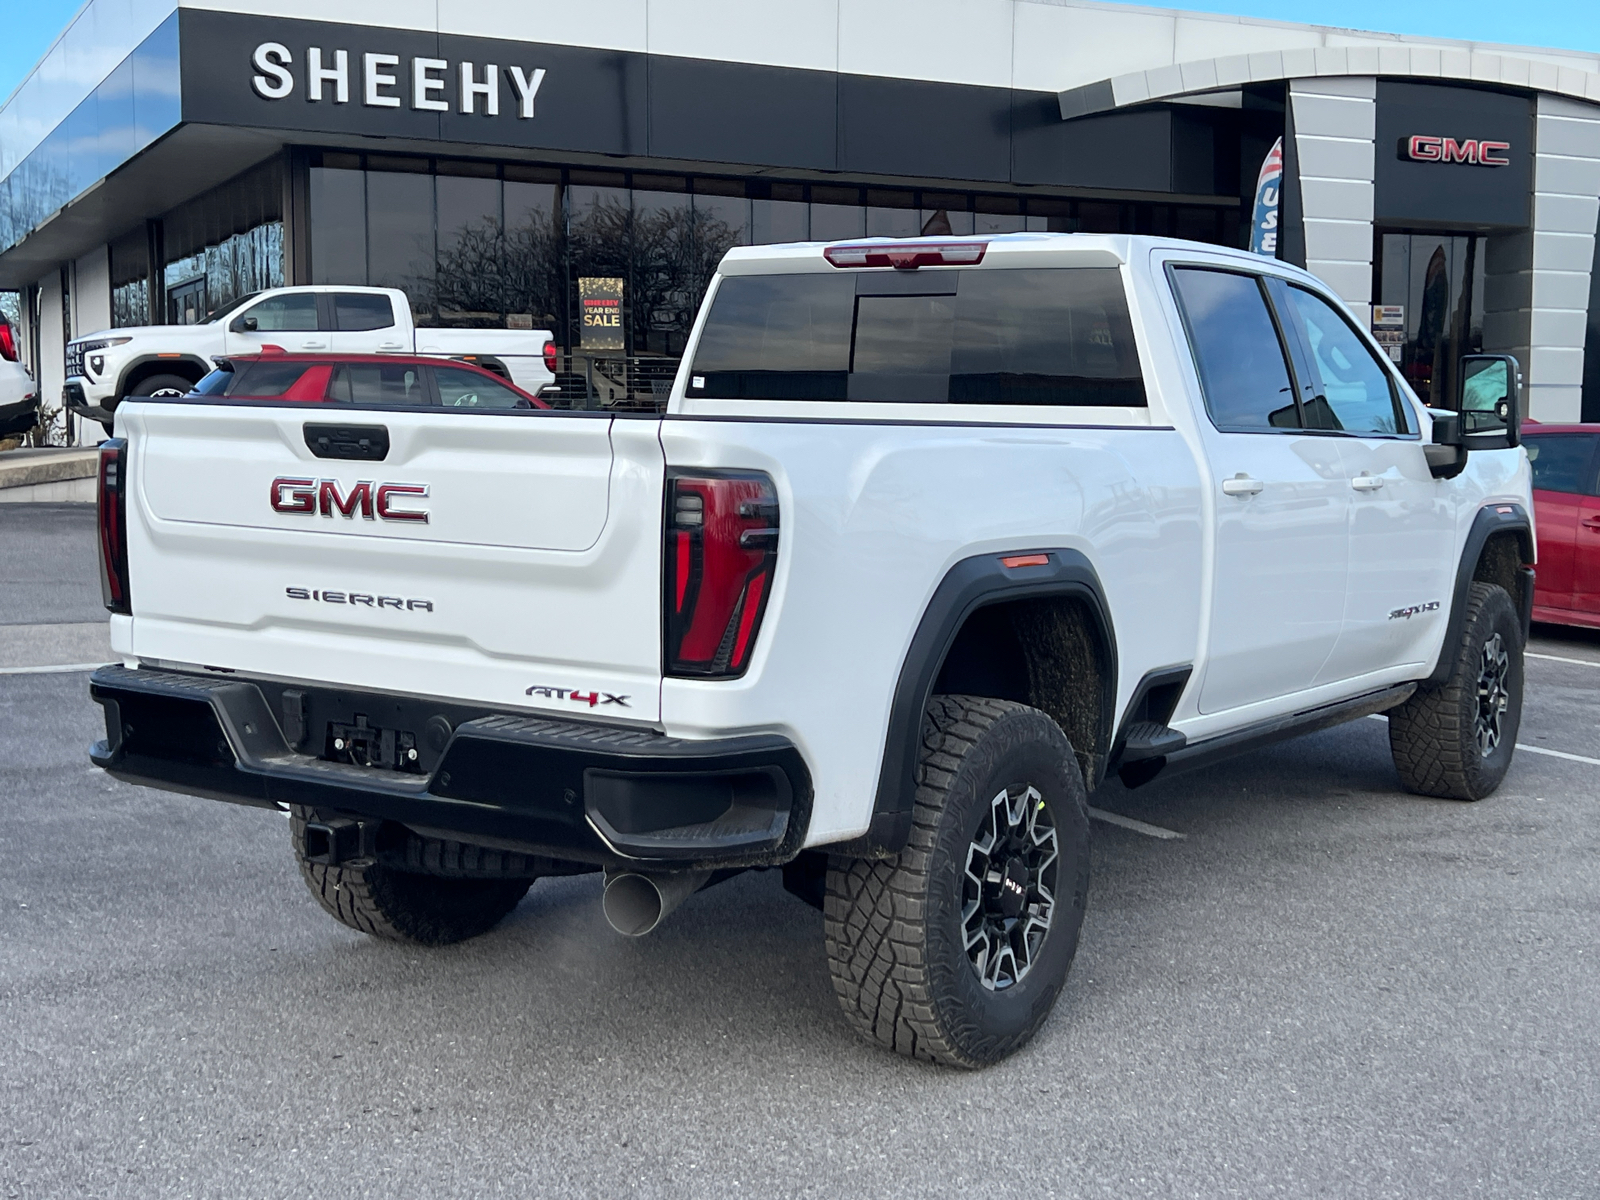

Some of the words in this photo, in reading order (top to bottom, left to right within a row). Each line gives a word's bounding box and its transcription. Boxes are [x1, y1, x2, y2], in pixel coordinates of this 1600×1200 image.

[251, 41, 546, 119] SHEEHY
[1408, 135, 1510, 166] GMC
[584, 315, 620, 326] SALE
[270, 475, 431, 525] GMC
[285, 586, 434, 613] SIERRA
[525, 685, 633, 709] AT4X
